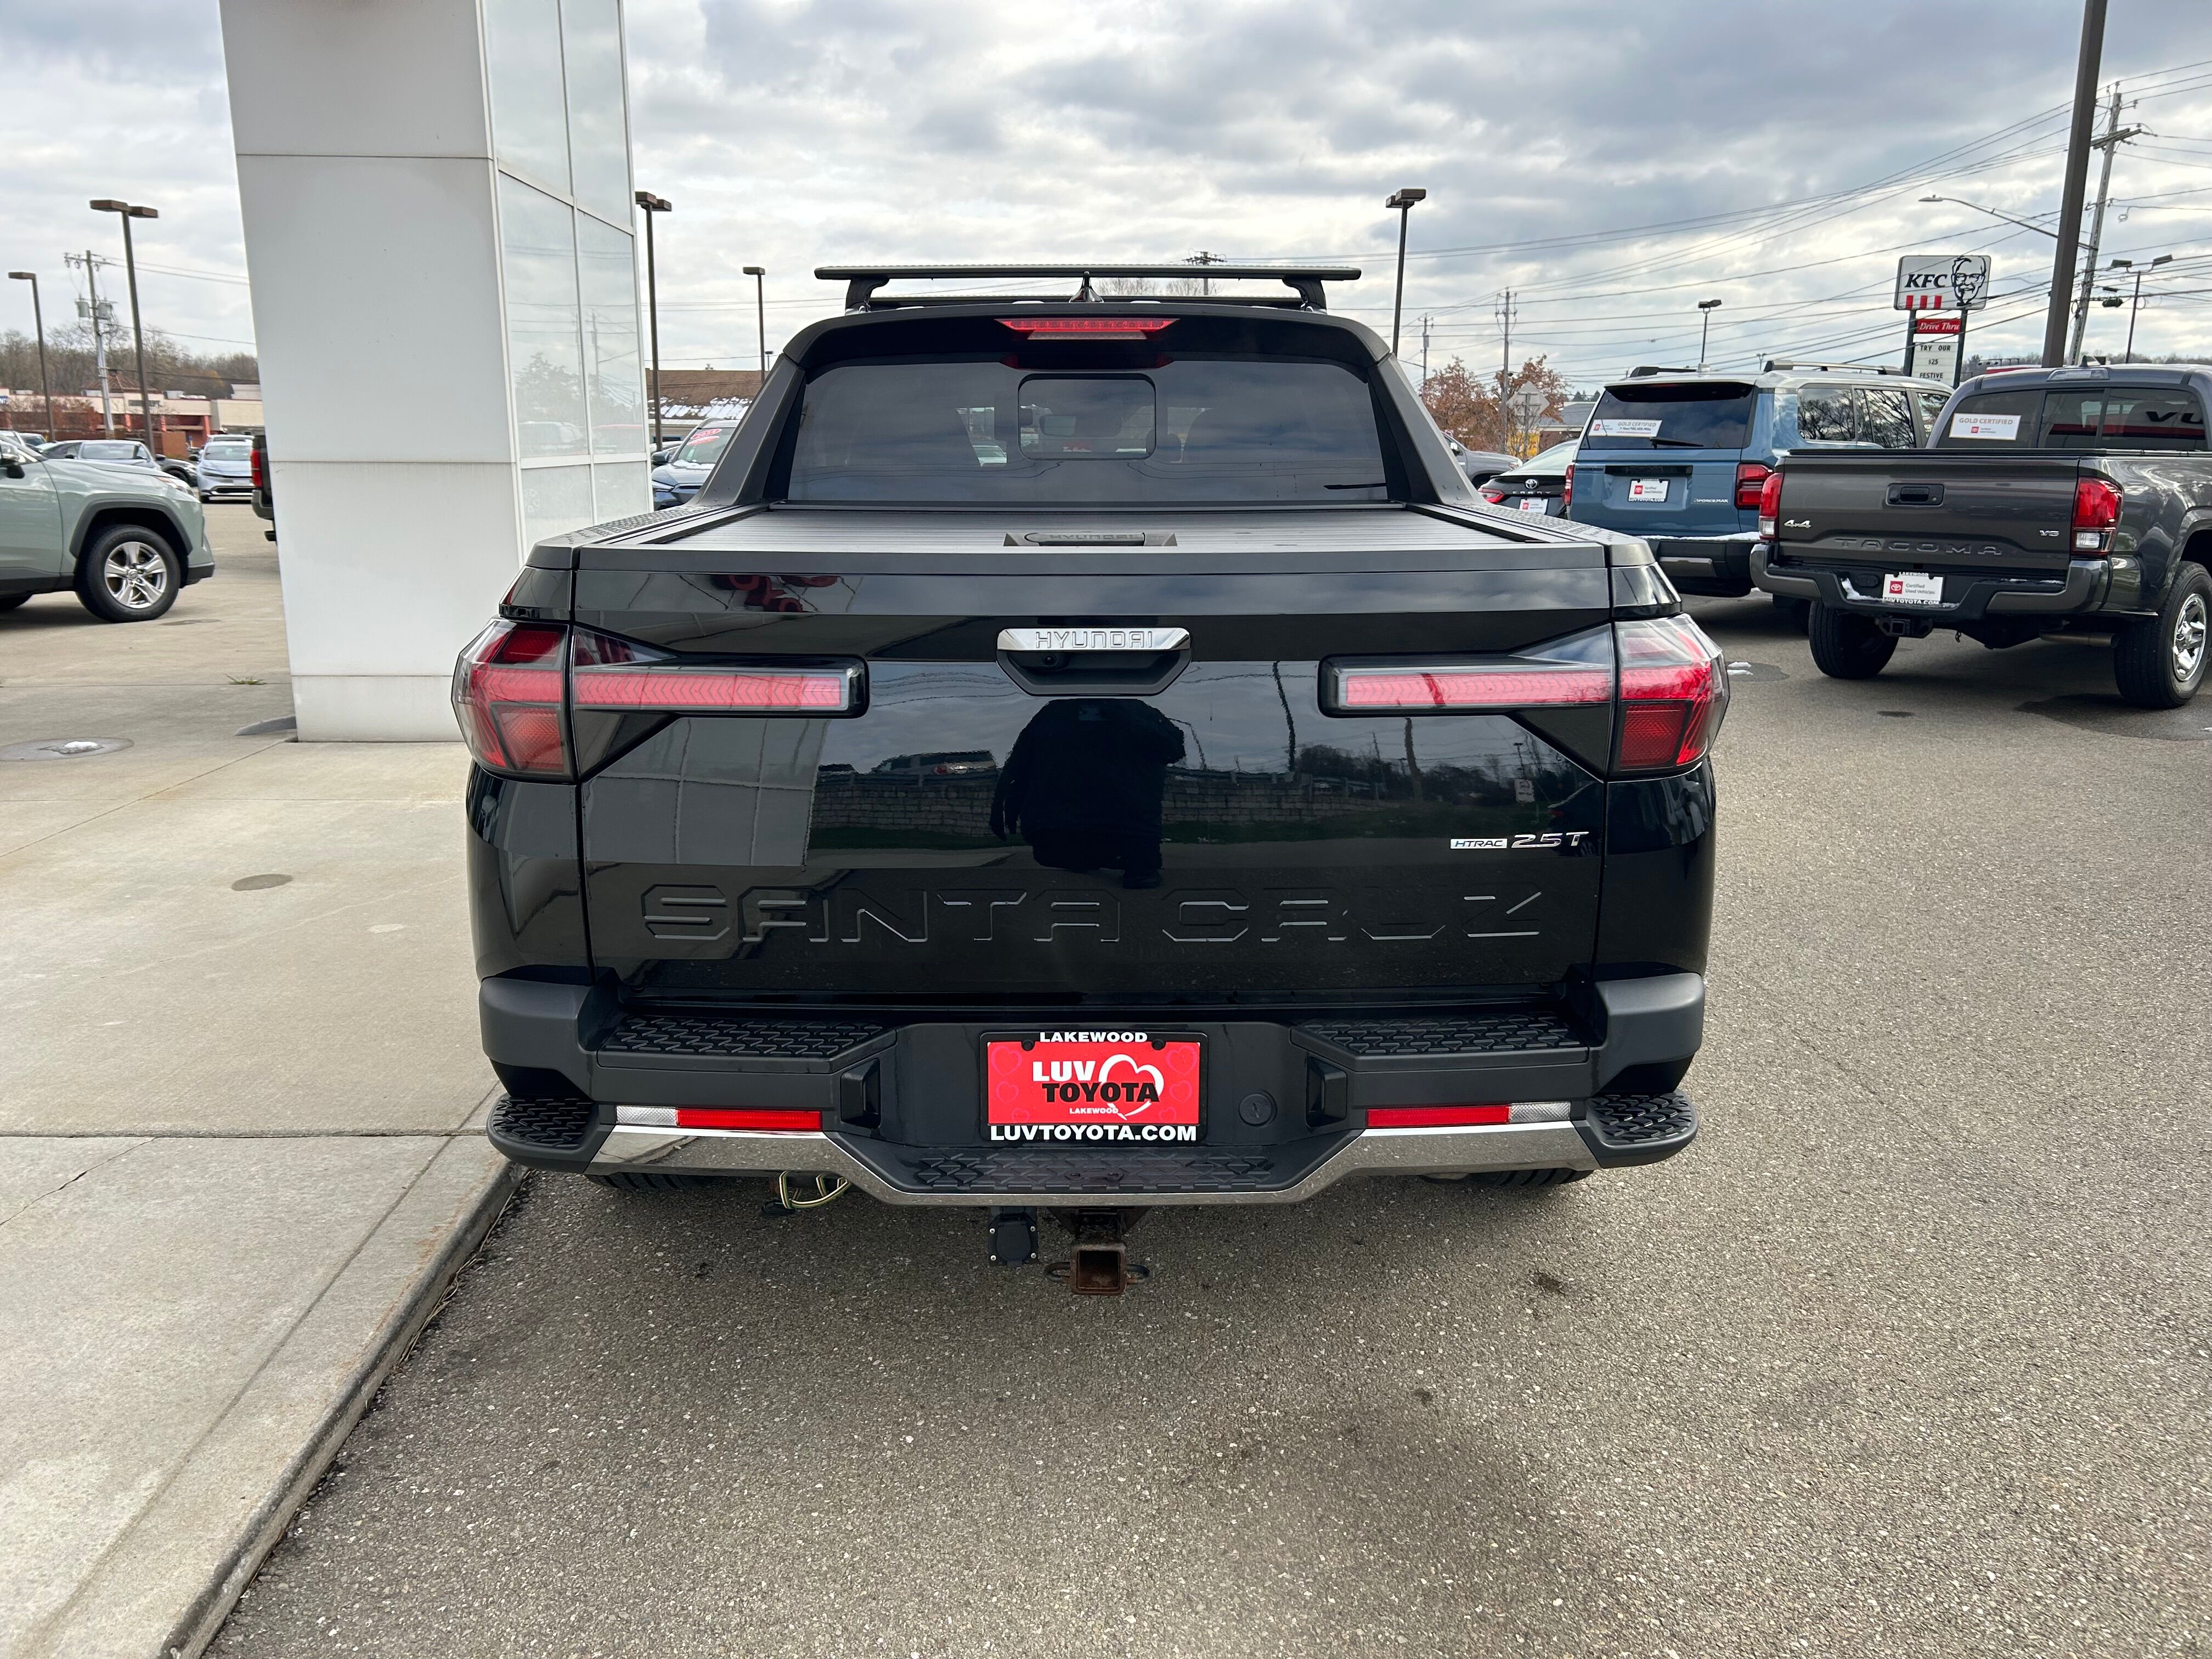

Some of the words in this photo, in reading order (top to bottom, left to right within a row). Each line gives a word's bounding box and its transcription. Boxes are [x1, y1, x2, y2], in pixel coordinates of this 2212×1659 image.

[1904, 274, 1948, 288] KFC
[1942, 322, 1960, 330] Thru
[1784, 520, 1812, 528] 4x4
[1835, 538, 2002, 555] TACOMA
[1035, 631, 1152, 648] HYUNDAI
[641, 884, 1120, 944] SANTA
[1161, 883, 1542, 942] CRUZ
[1040, 1032, 1148, 1042] LAKEWOOD
[1032, 1060, 1096, 1082] LUV
[1042, 1082, 1160, 1103] TOYOTA
[990, 1125, 1197, 1141] LUVTOYOTA.COM
